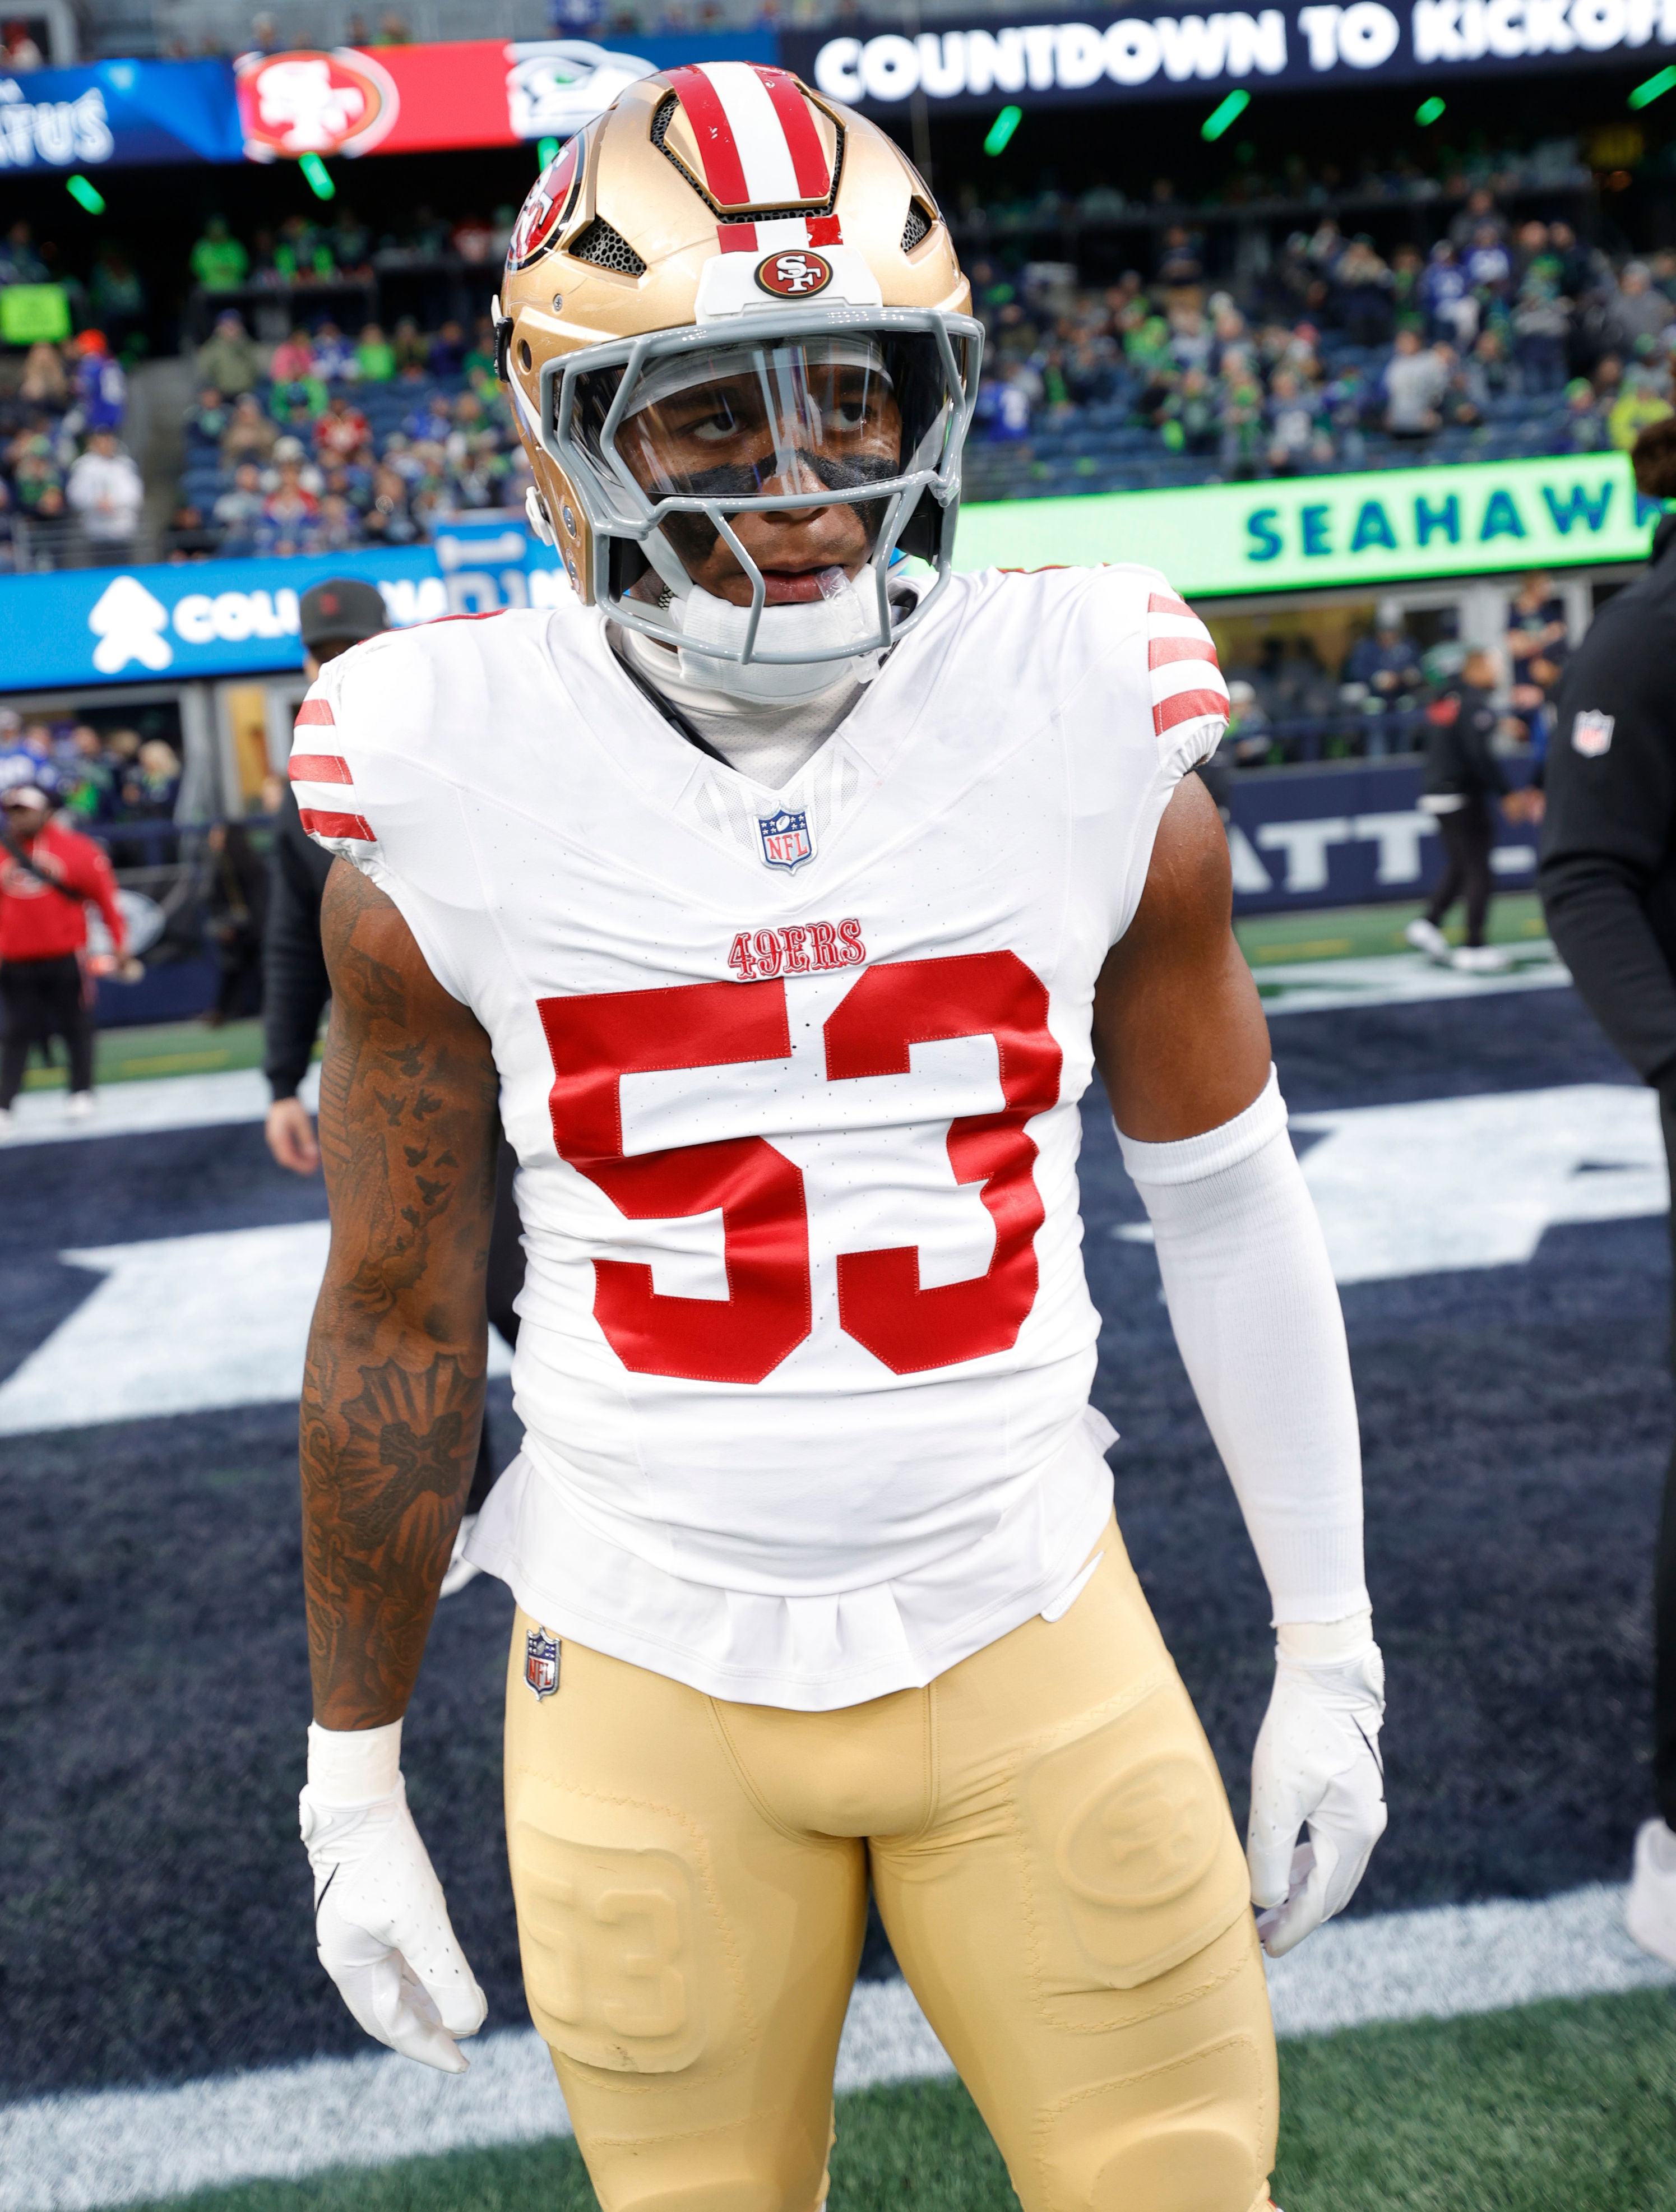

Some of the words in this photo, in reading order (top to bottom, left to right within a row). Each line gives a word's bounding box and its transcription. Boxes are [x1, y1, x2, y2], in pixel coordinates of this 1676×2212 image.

[814, 8, 1288, 105] COUNTDOWN
[1297, 1, 1400, 72] TO
[776, 254, 822, 293] SF
[767, 832, 808, 861] NFL
[728, 918, 867, 980] 49ERS
[536, 949, 1063, 1385] 53
[529, 1656, 553, 1688] NFL
